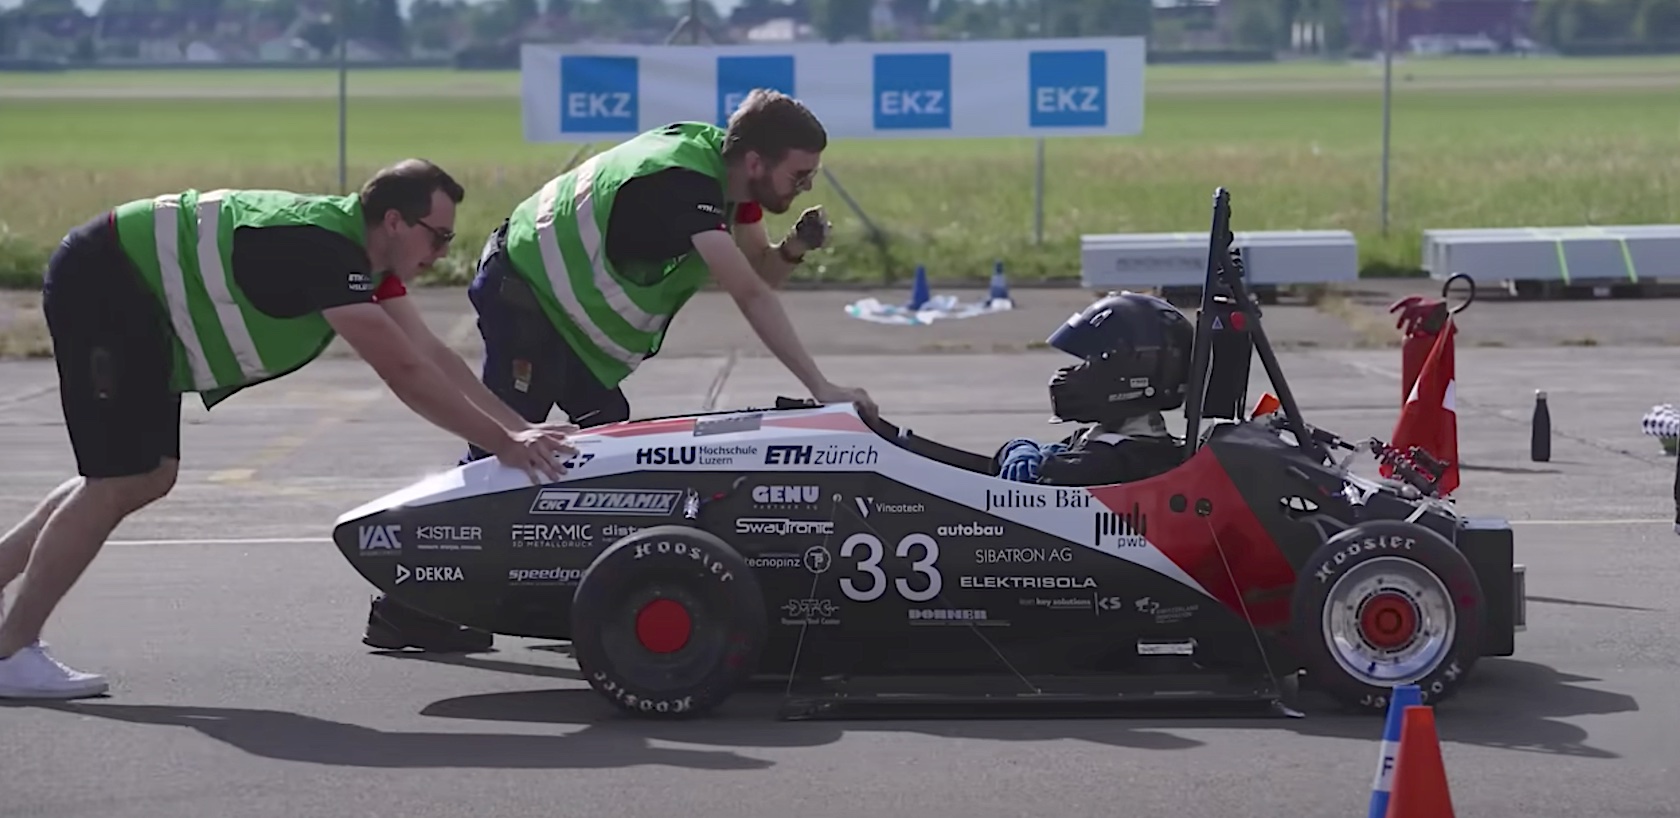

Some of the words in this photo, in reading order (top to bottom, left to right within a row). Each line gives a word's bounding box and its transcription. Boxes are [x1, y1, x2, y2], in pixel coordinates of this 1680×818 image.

[568, 92, 631, 118] EKZ
[880, 90, 944, 115] EKZ
[1036, 86, 1099, 112] EKZ
[635, 445, 697, 466] HSLU
[699, 445, 758, 456] Hochschule
[699, 455, 733, 466] Luzern
[538, 500, 565, 511] CNC
[579, 492, 676, 509] DYNAMIX
[752, 485, 819, 503] GENU
[985, 489, 1047, 511] Julius
[1055, 489, 1094, 508] Bär
[875, 502, 925, 512] Vincotech
[416, 526, 482, 540] KISTLER
[512, 524, 594, 541] FERAMIC
[735, 518, 835, 536] Swaytronic
[937, 521, 1004, 536] autobau
[358, 525, 402, 549] VAC
[1118, 536, 1147, 549] pwb
[975, 549, 1046, 564] SIBATRON
[1049, 547, 1073, 562] AG
[415, 567, 464, 581] DEKRA
[839, 533, 943, 602] 33
[960, 576, 1098, 589] ELEKTRISOLA
